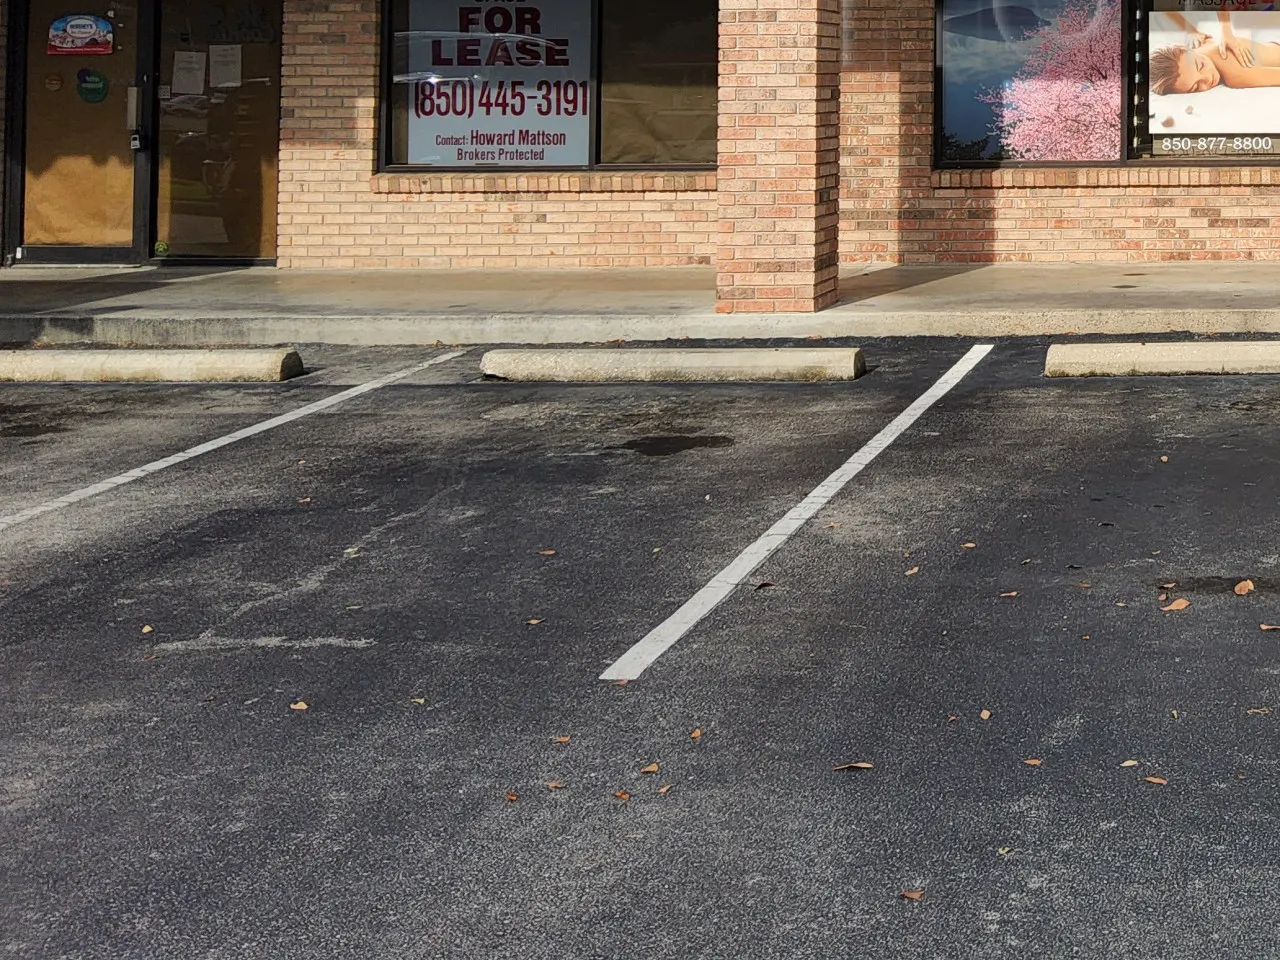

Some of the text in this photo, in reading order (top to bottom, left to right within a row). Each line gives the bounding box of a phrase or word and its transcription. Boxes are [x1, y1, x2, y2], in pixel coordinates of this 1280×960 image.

[458, 6, 542, 35] FOR
[431, 38, 570, 67] LEASE
[435, 129, 566, 146] Contact: Howard Mattson
[1161, 136, 1272, 151] 850-877-8800
[456, 148, 545, 161] Brokers Protected
